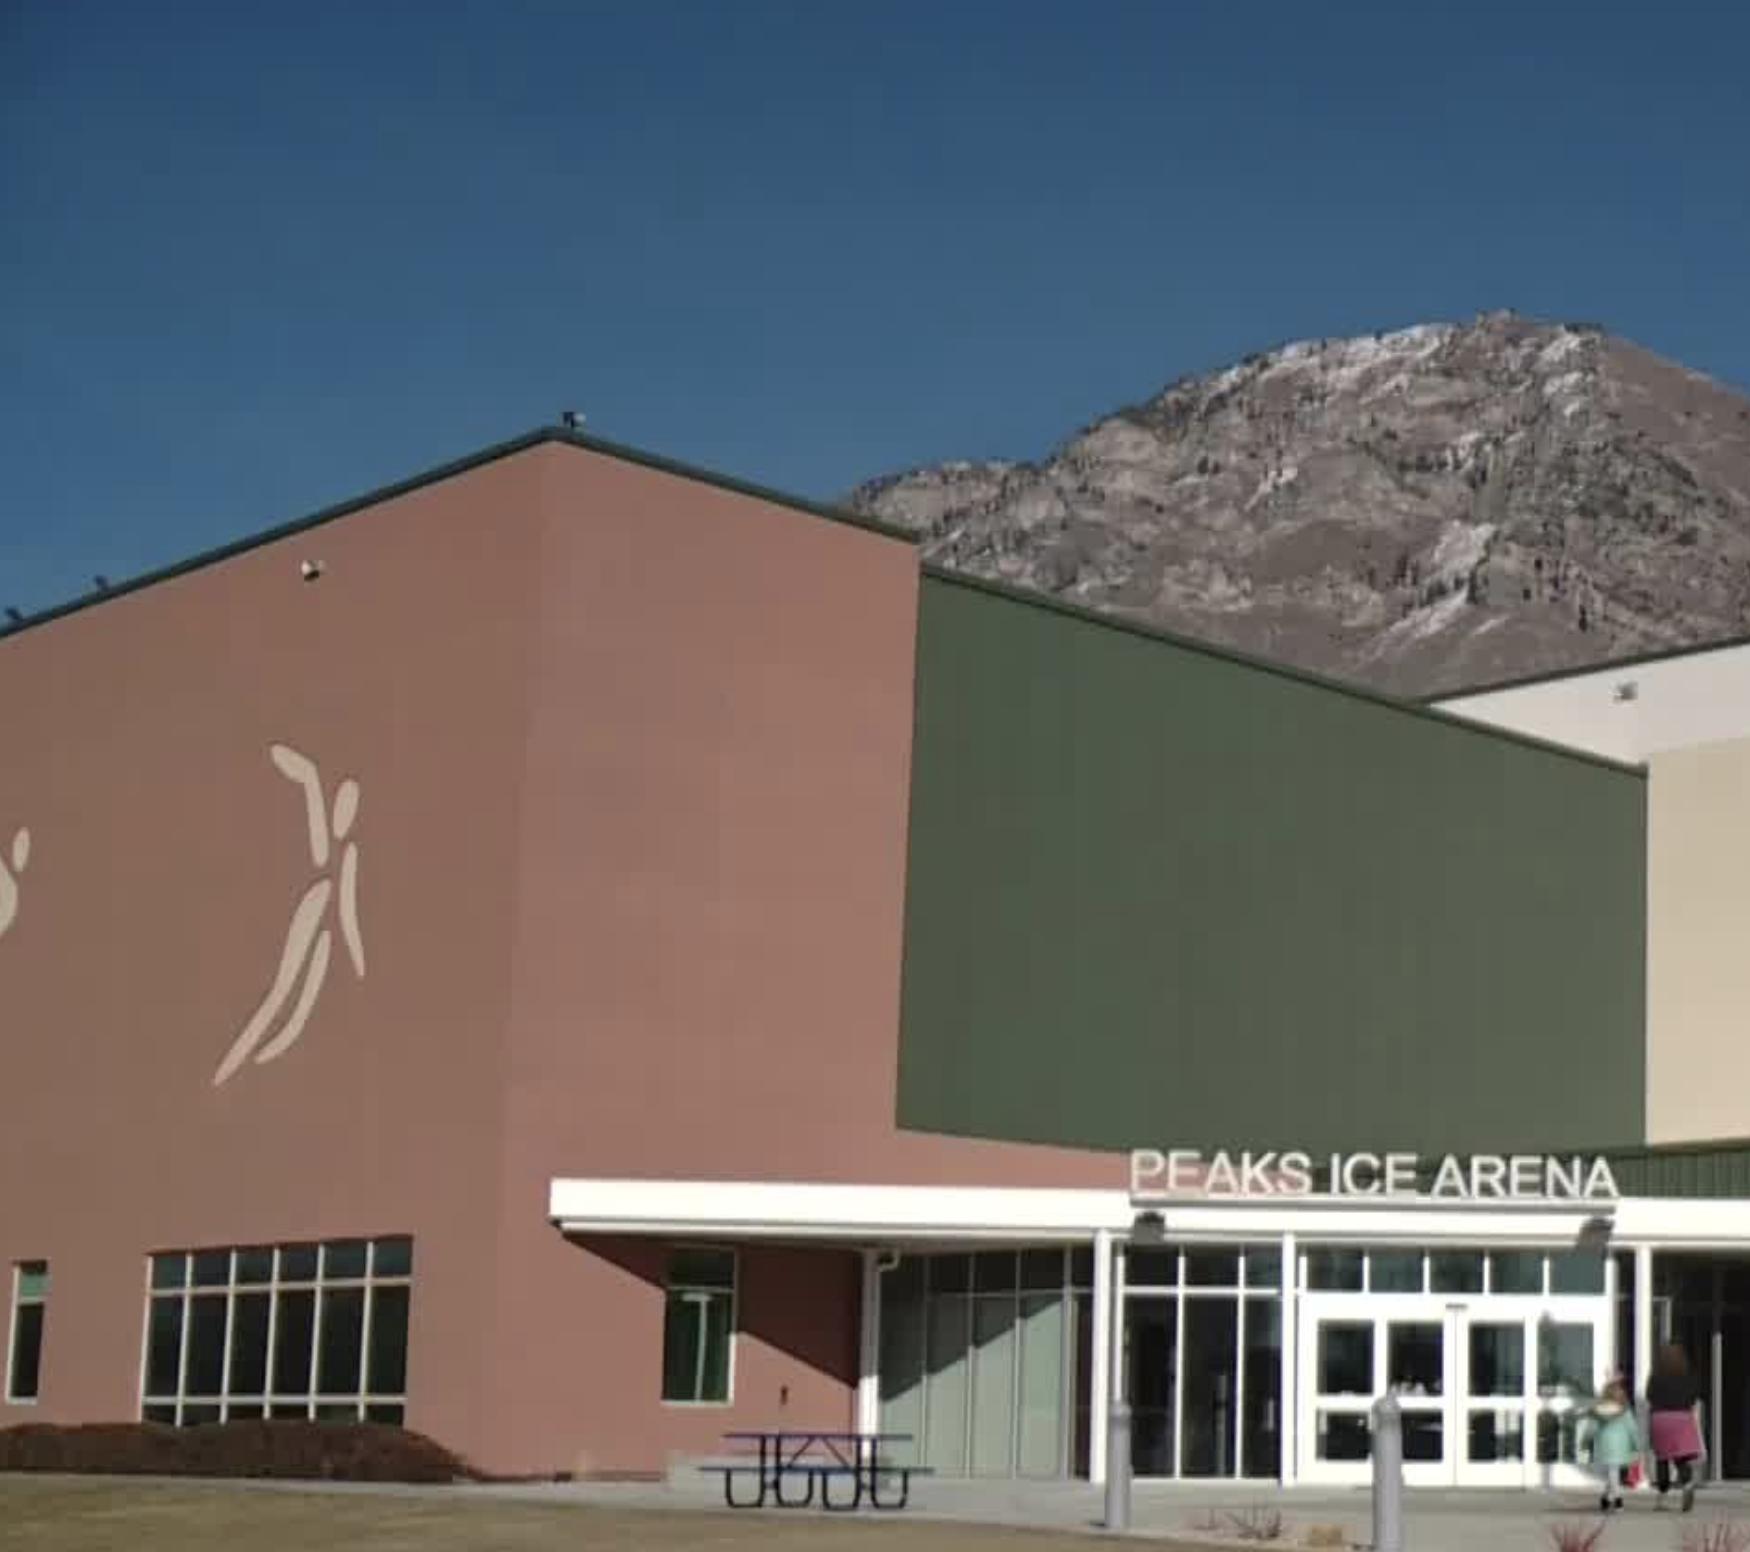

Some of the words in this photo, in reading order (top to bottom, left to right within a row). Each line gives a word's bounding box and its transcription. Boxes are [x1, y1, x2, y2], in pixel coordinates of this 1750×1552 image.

[1130, 1150, 1312, 1197] PEAKS
[1331, 1153, 1418, 1199] ICE
[1431, 1156, 1619, 1199] ARENA
